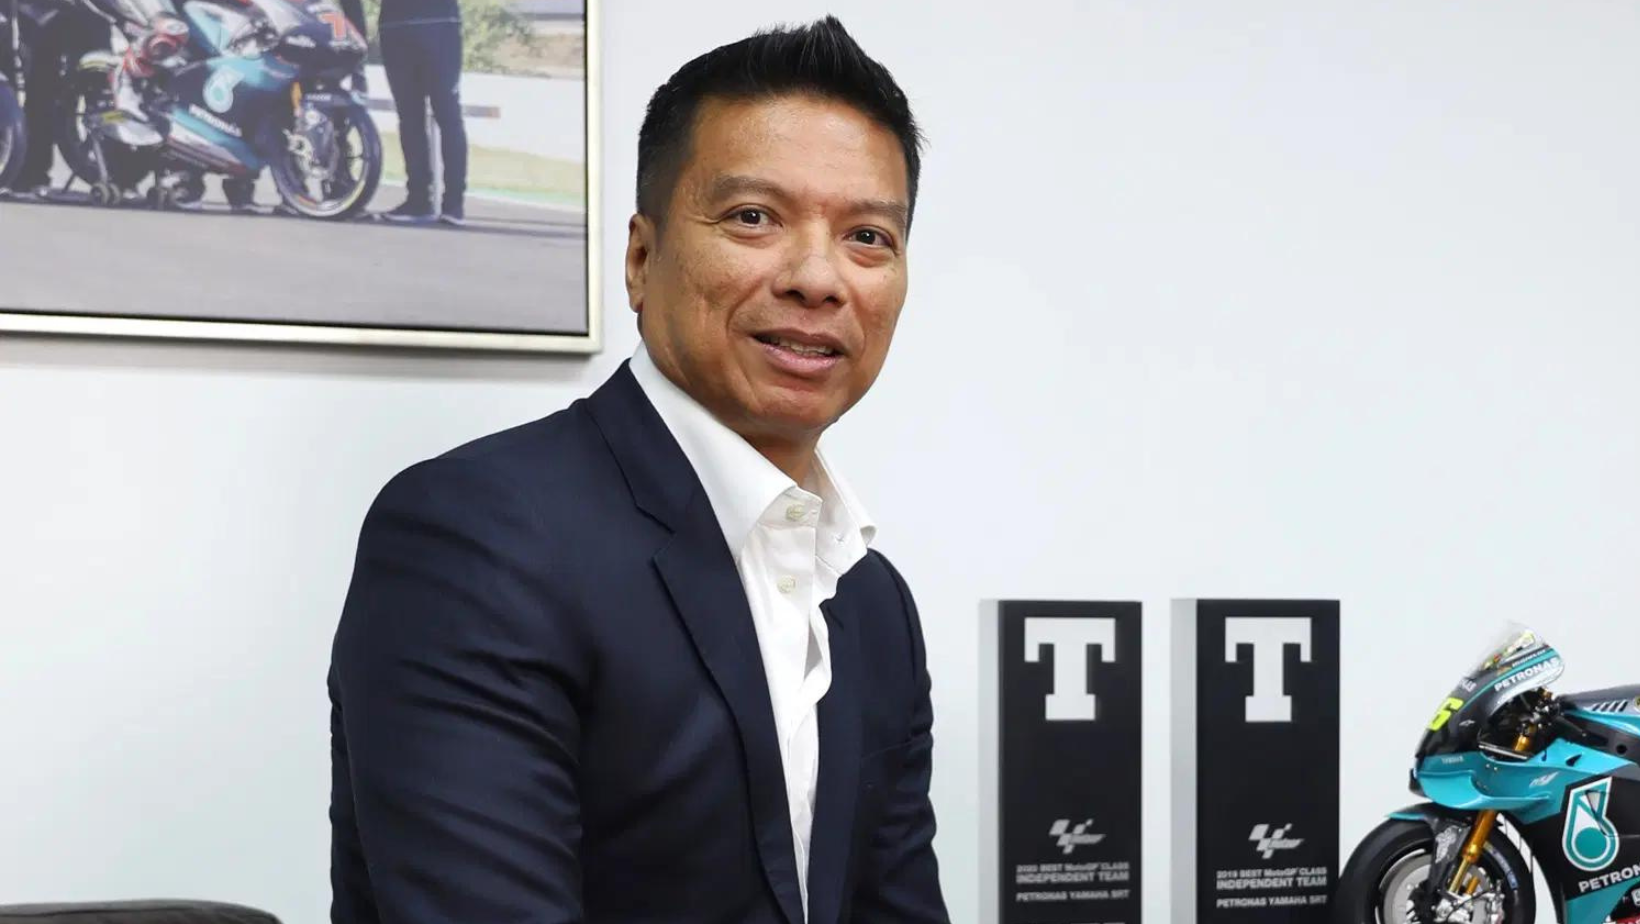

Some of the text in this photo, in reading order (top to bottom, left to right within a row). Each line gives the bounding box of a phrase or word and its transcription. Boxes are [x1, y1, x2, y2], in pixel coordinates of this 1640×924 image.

[1024, 617, 1116, 721] T
[1225, 617, 1312, 722] T
[1494, 656, 1561, 692] PETRONAS
[1040, 863, 1062, 872] BEST
[1240, 868, 1262, 878] BEST
[1299, 866, 1327, 876] CLASS
[1016, 870, 1129, 884] INDEPENDENT TEAM
[1216, 876, 1327, 890] INDEPENDENT TEAM
[1016, 889, 1130, 901] PETRONAS YAMAHA SRT
[1216, 895, 1327, 908] PETRONAS YAMAHA SRT
